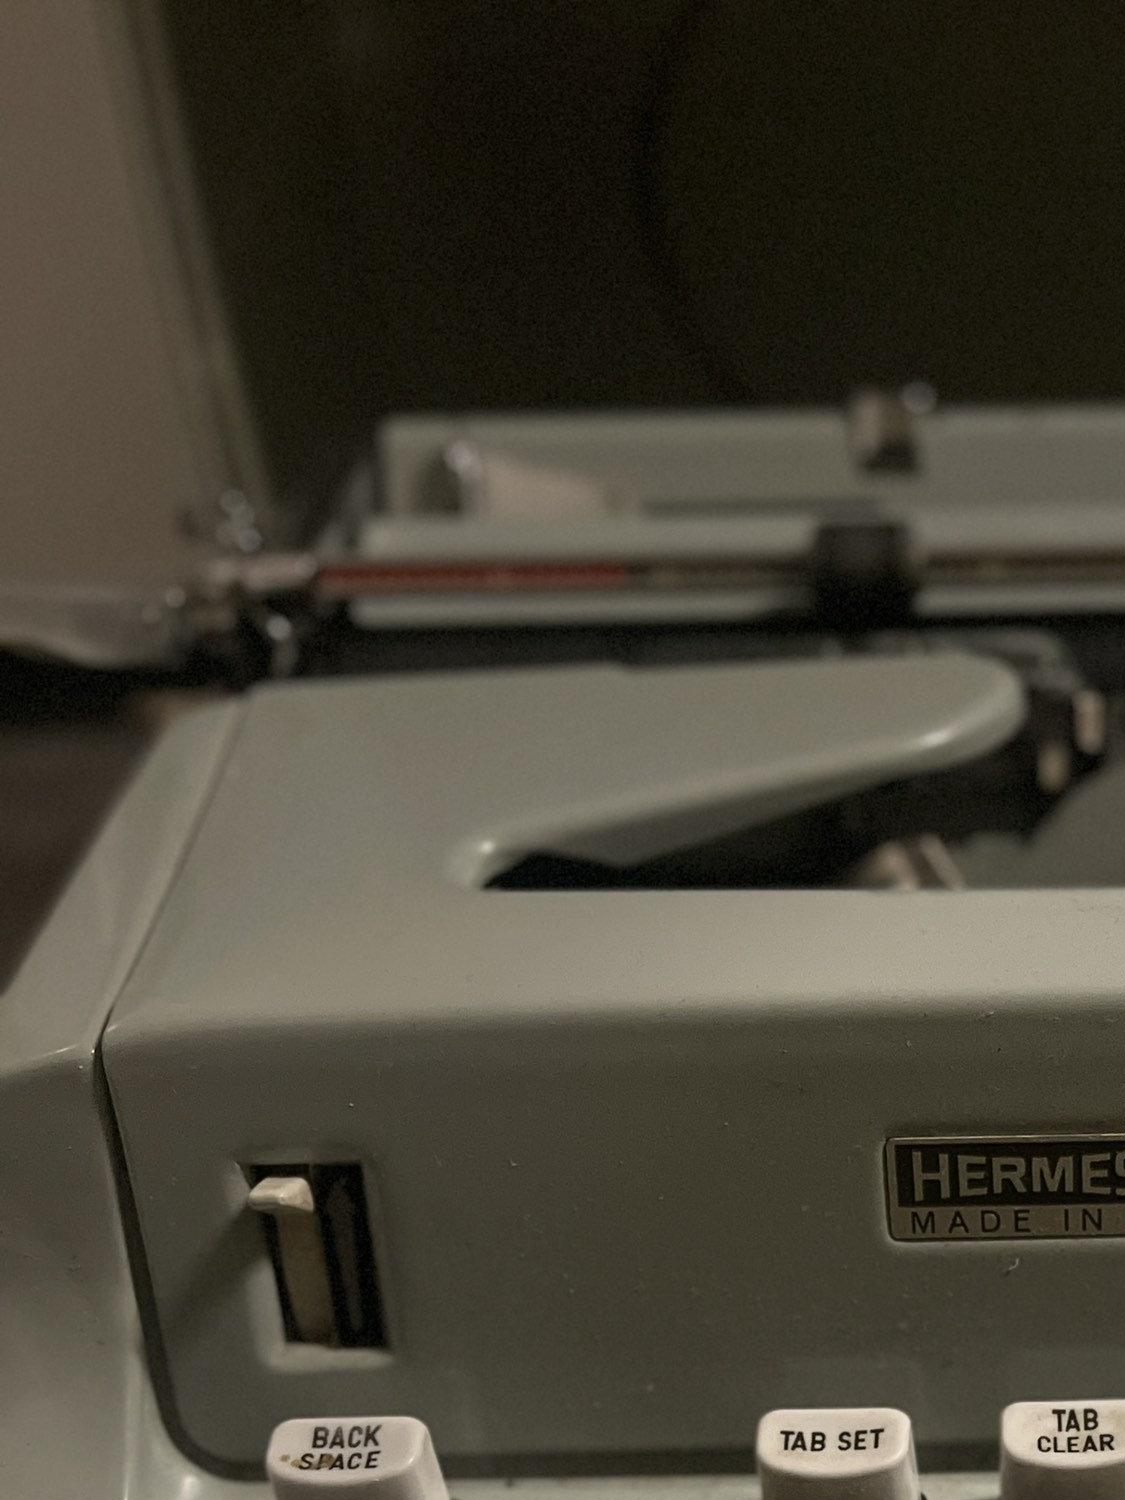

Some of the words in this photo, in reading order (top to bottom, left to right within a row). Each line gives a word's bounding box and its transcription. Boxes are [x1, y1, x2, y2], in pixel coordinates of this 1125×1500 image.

[910, 1204, 1033, 1235] MADE
[1061, 1206, 1103, 1232] IN
[1051, 1408, 1099, 1433] TAB
[311, 1425, 382, 1450] BACK
[779, 1430, 827, 1452] TAB
[837, 1428, 885, 1451] SET
[1037, 1433, 1115, 1453] CLEAR
[297, 1450, 381, 1471] SPACE
